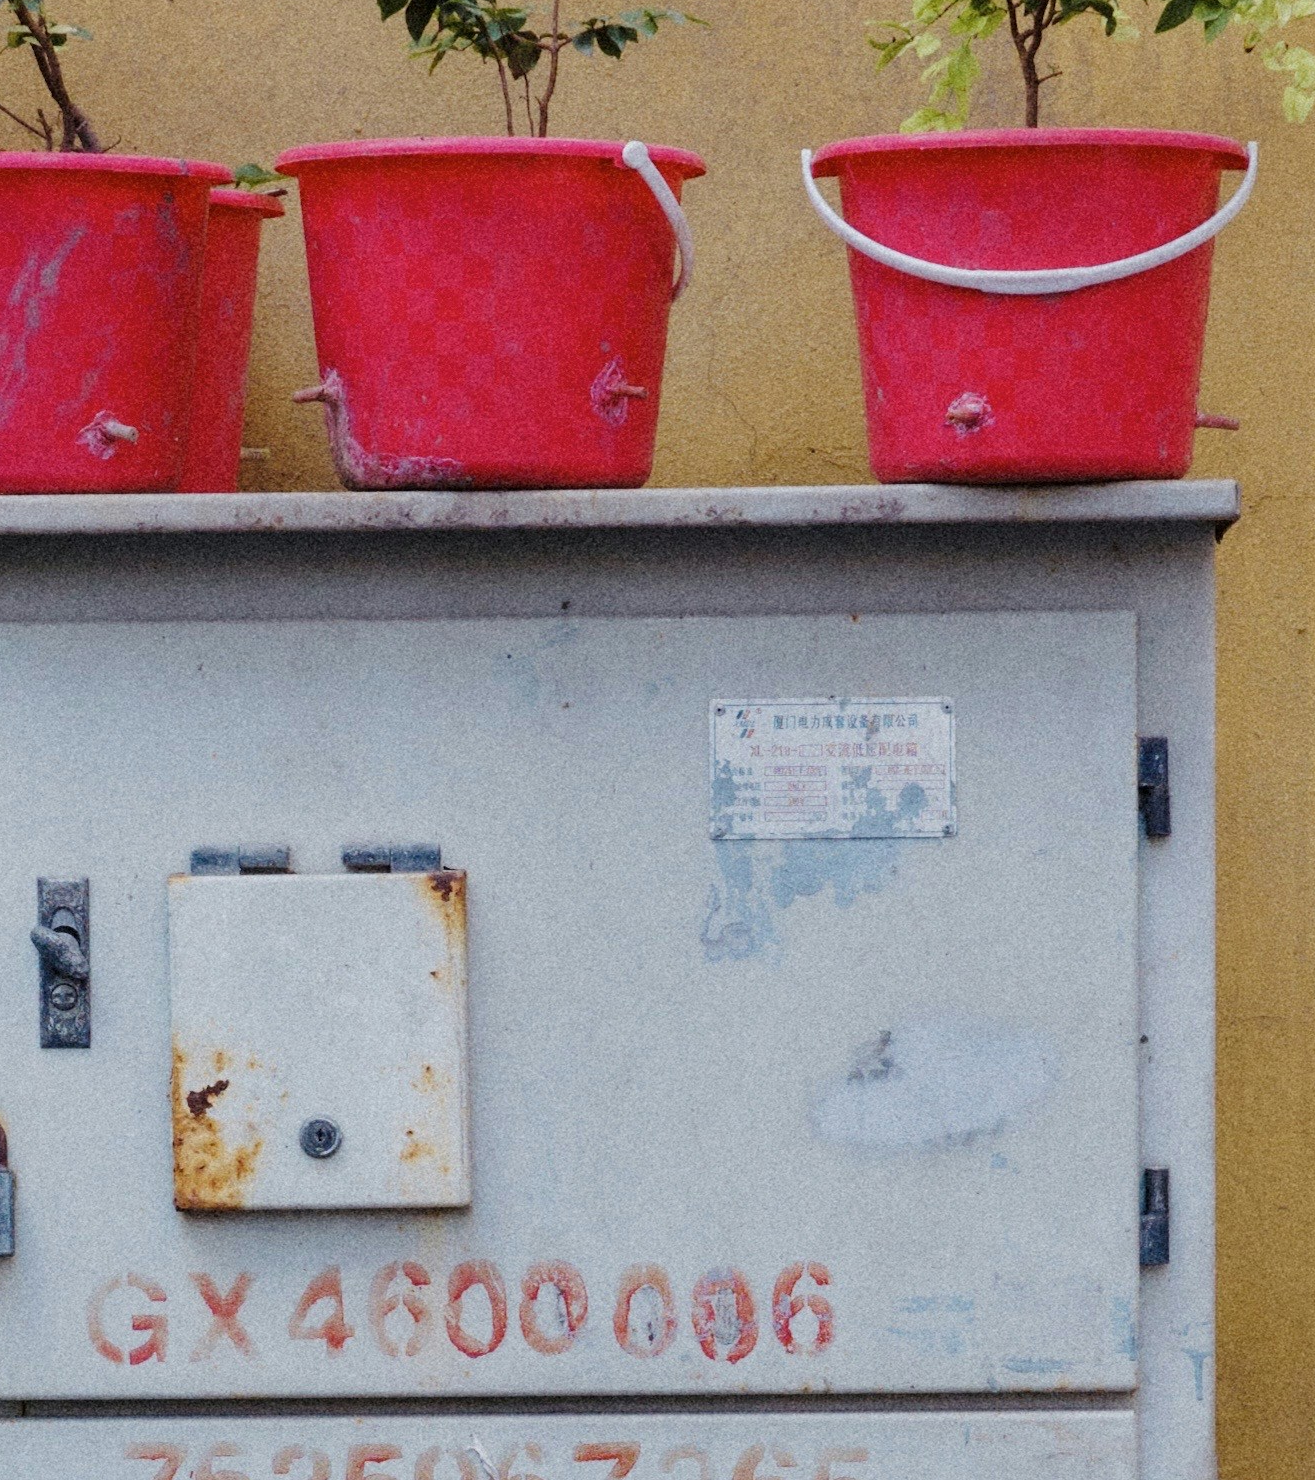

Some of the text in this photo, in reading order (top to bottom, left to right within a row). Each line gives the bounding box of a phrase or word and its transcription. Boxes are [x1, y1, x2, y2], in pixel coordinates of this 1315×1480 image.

[773, 714, 918, 730] 厦门电力成套设备有限公司
